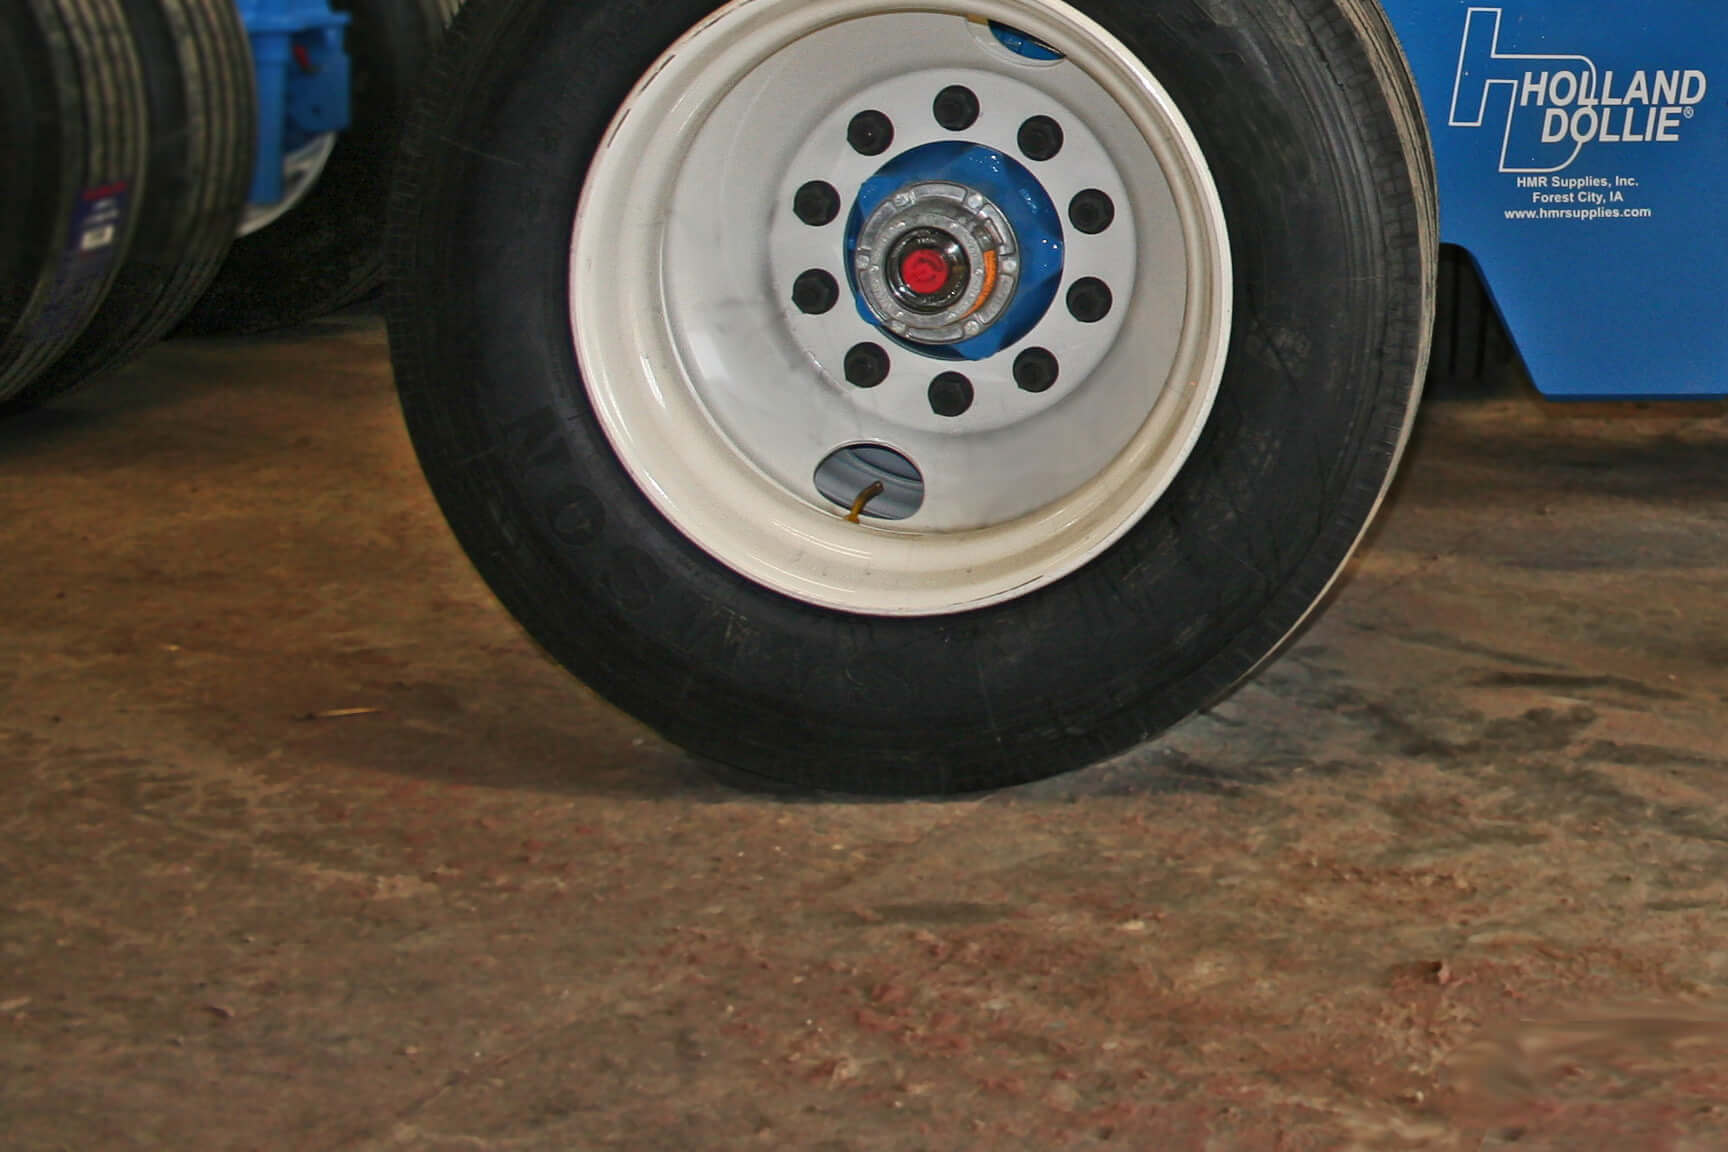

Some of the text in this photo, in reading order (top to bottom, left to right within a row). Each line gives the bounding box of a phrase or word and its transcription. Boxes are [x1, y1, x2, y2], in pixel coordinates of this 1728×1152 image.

[1519, 69, 1707, 107] HOLLAND
[1516, 175, 1639, 190] HMR Supplies, Inc.
[1532, 190, 1624, 205] Forest City, IA
[1504, 207, 1651, 220] www.hmrsupplies.com
